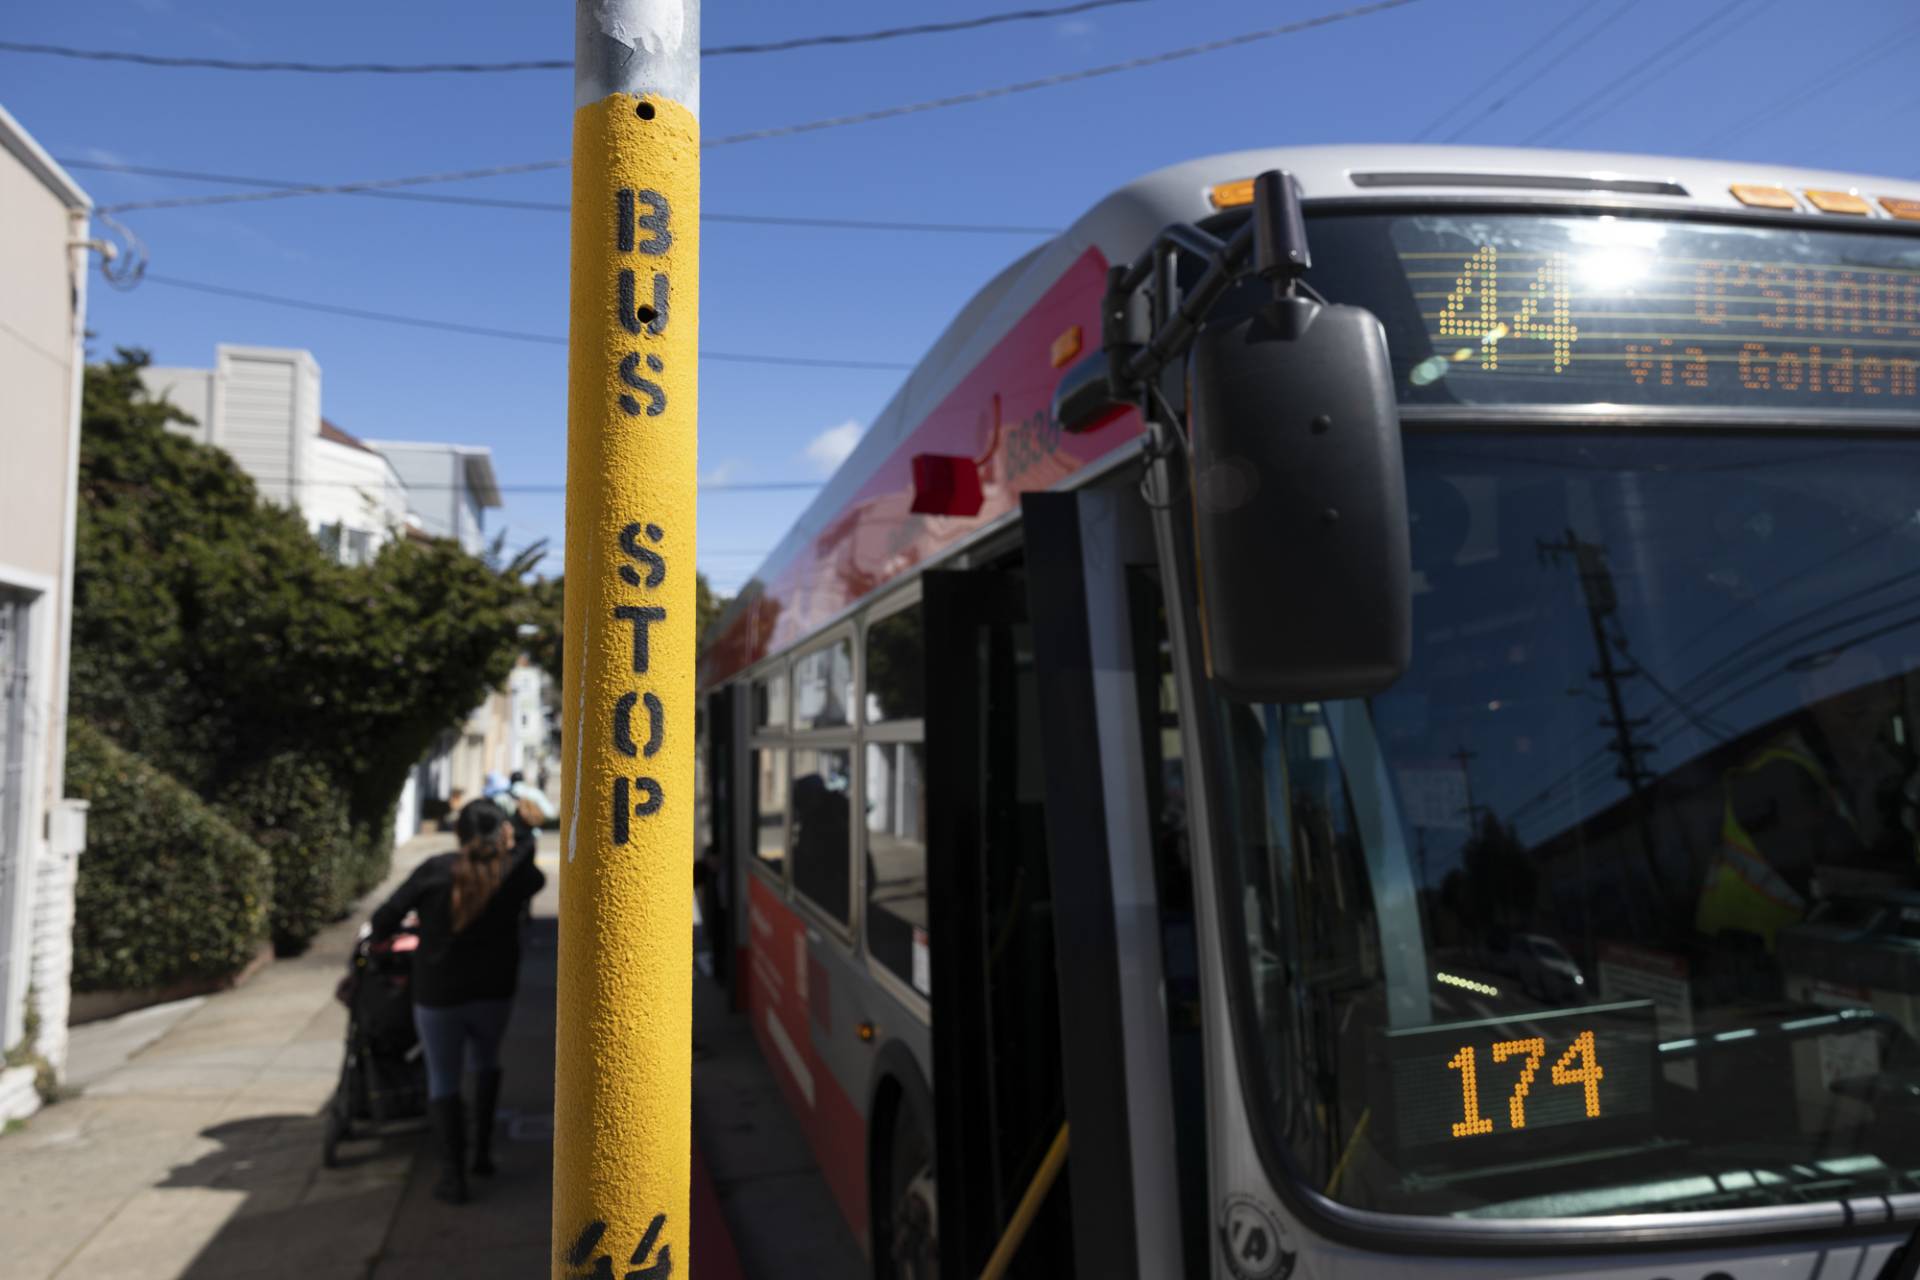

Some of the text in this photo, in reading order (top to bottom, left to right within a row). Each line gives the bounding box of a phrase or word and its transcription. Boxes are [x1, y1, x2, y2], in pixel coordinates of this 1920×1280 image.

[1439, 245, 1579, 373] 44
[1626, 338, 1917, 396] via Golden
[613, 187, 673, 845] BUS STOP
[1448, 1030, 1604, 1138] 174
